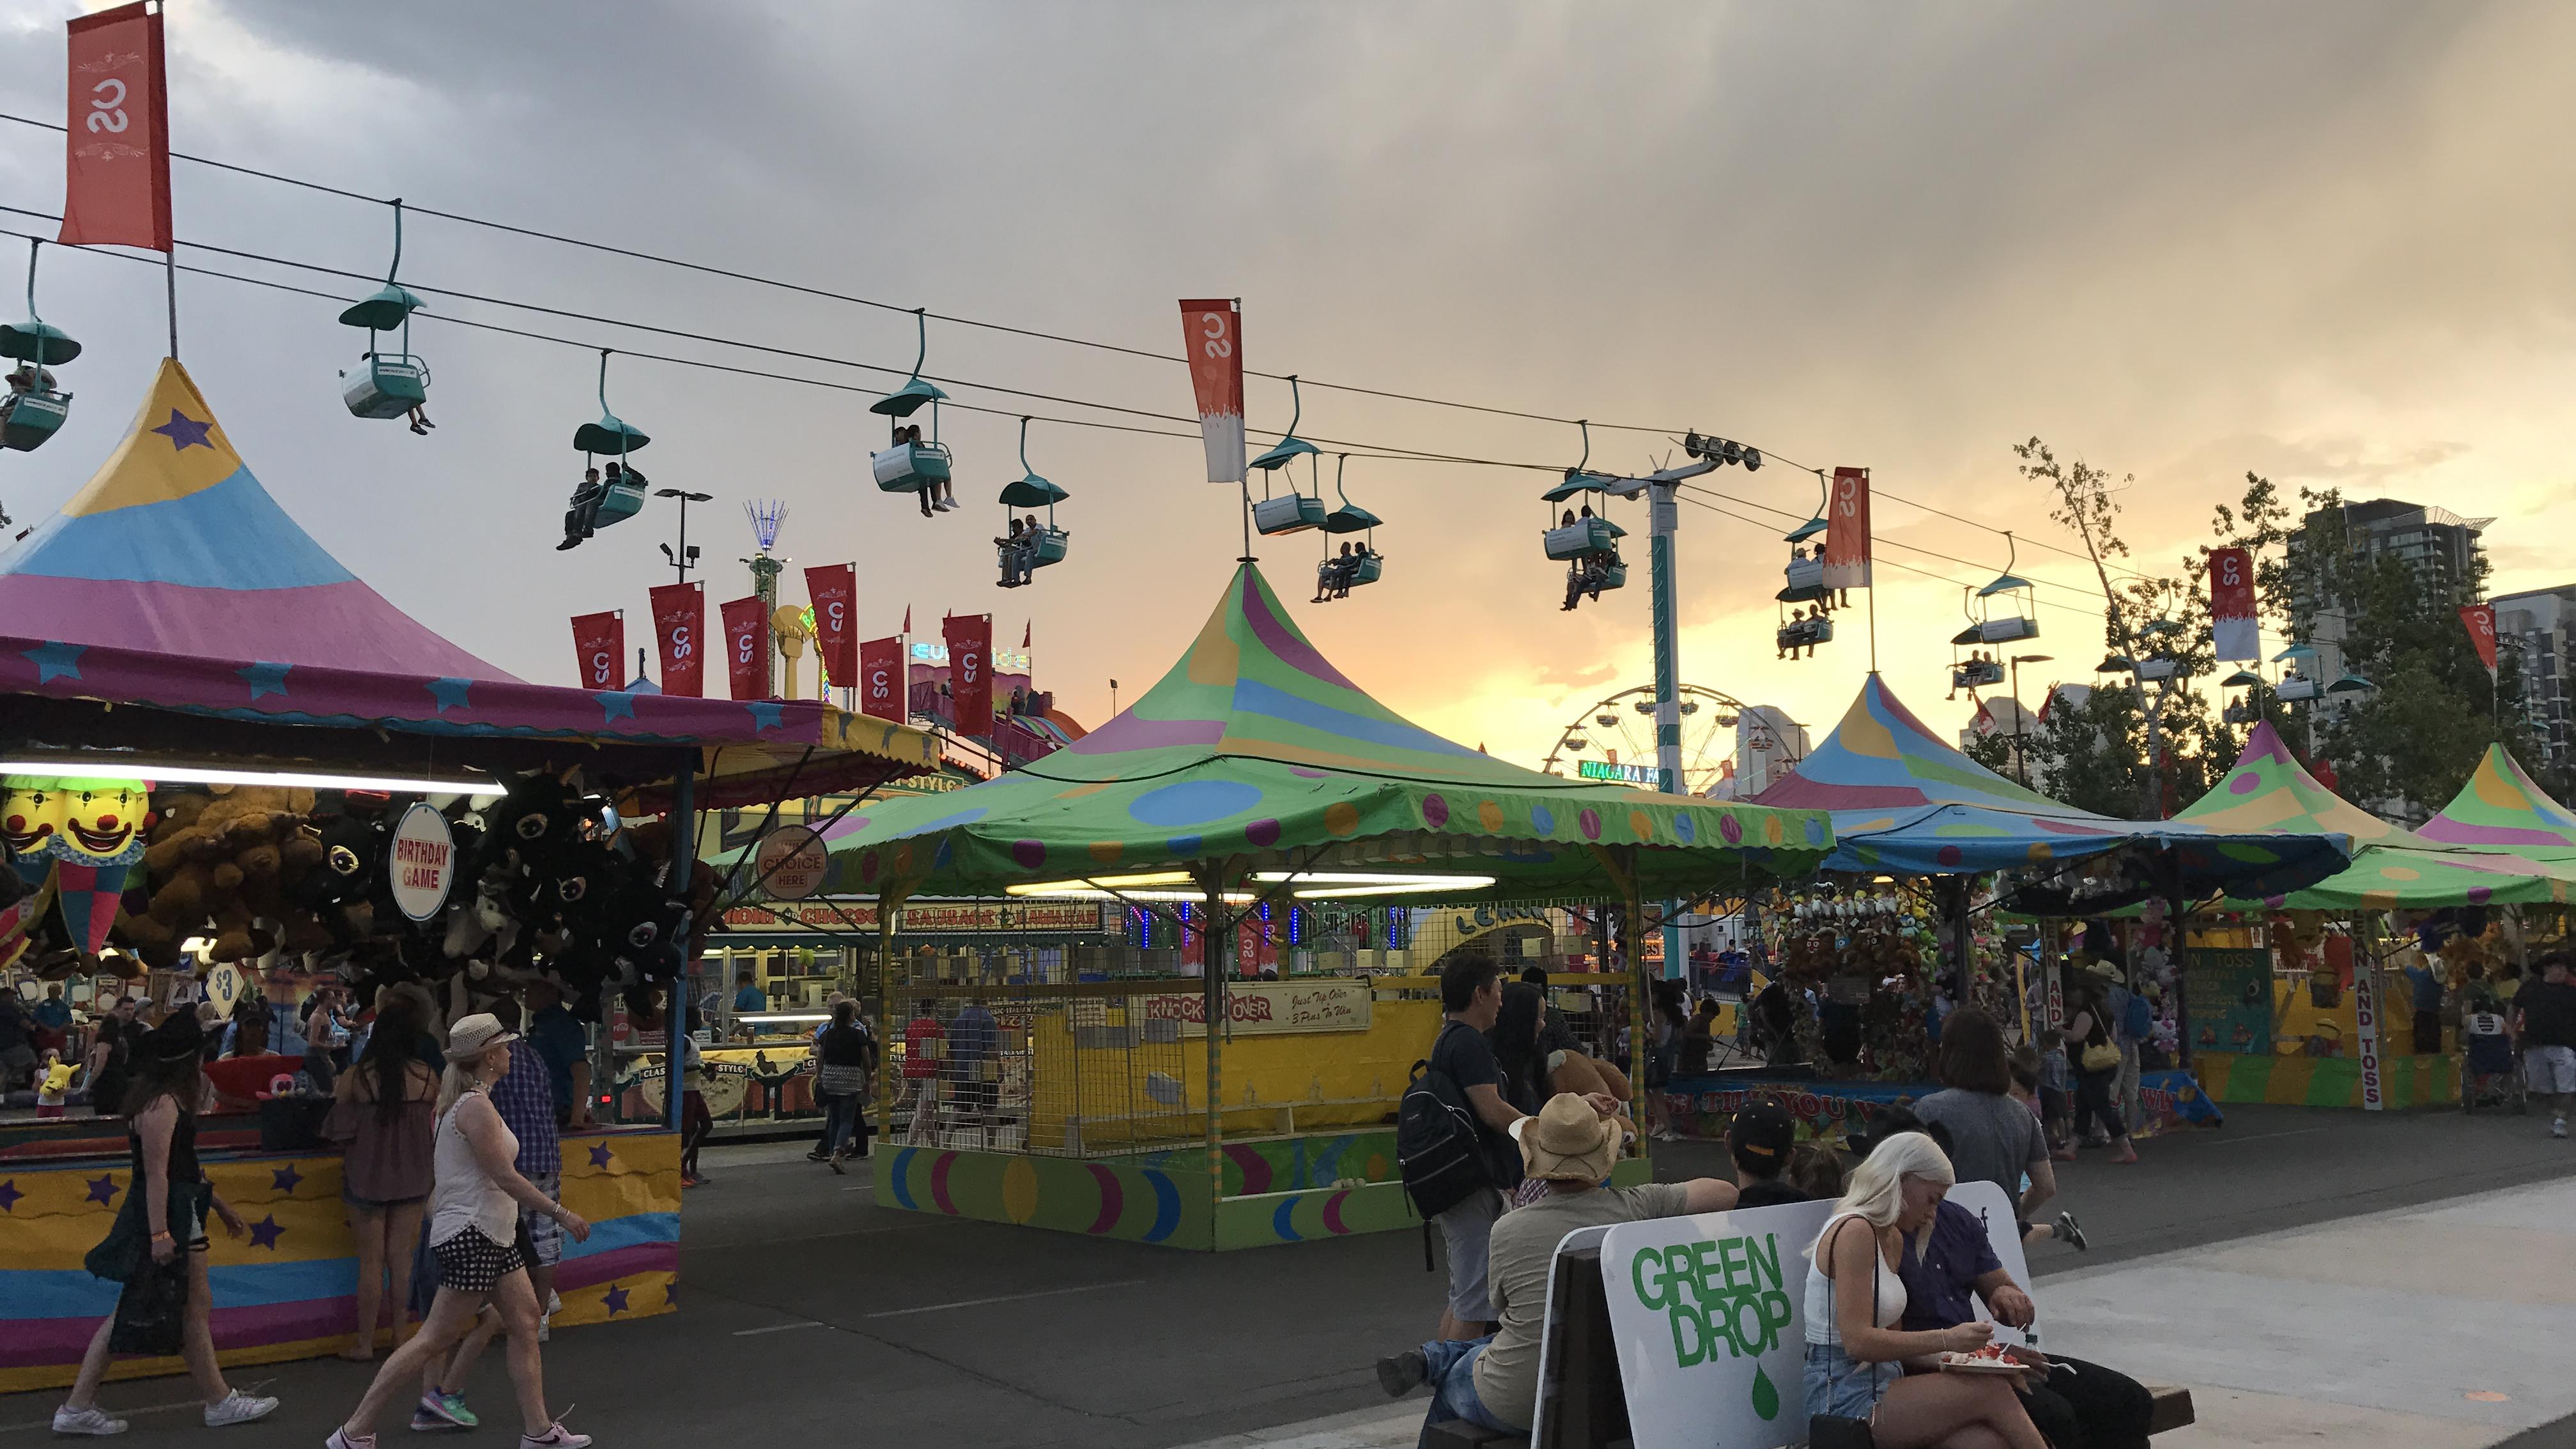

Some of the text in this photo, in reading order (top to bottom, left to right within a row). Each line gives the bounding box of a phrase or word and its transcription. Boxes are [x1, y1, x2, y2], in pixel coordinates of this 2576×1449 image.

[1582, 762, 1641, 783] NIAGARA
[397, 838, 449, 866] BIRTHDAY
[403, 866, 440, 889] GAME
[778, 875, 805, 885] HERE
[216, 969, 232, 1002] $3
[1233, 997, 1268, 1019] OVER
[1292, 1013, 1299, 1024] 3
[718, 1064, 744, 1073] STYLE
[2362, 1038, 2379, 1103] TOSS
[1776, 1090, 1845, 1121] YOU
[1631, 1232, 1785, 1311] GREEN
[1669, 1289, 1793, 1368] DROP
